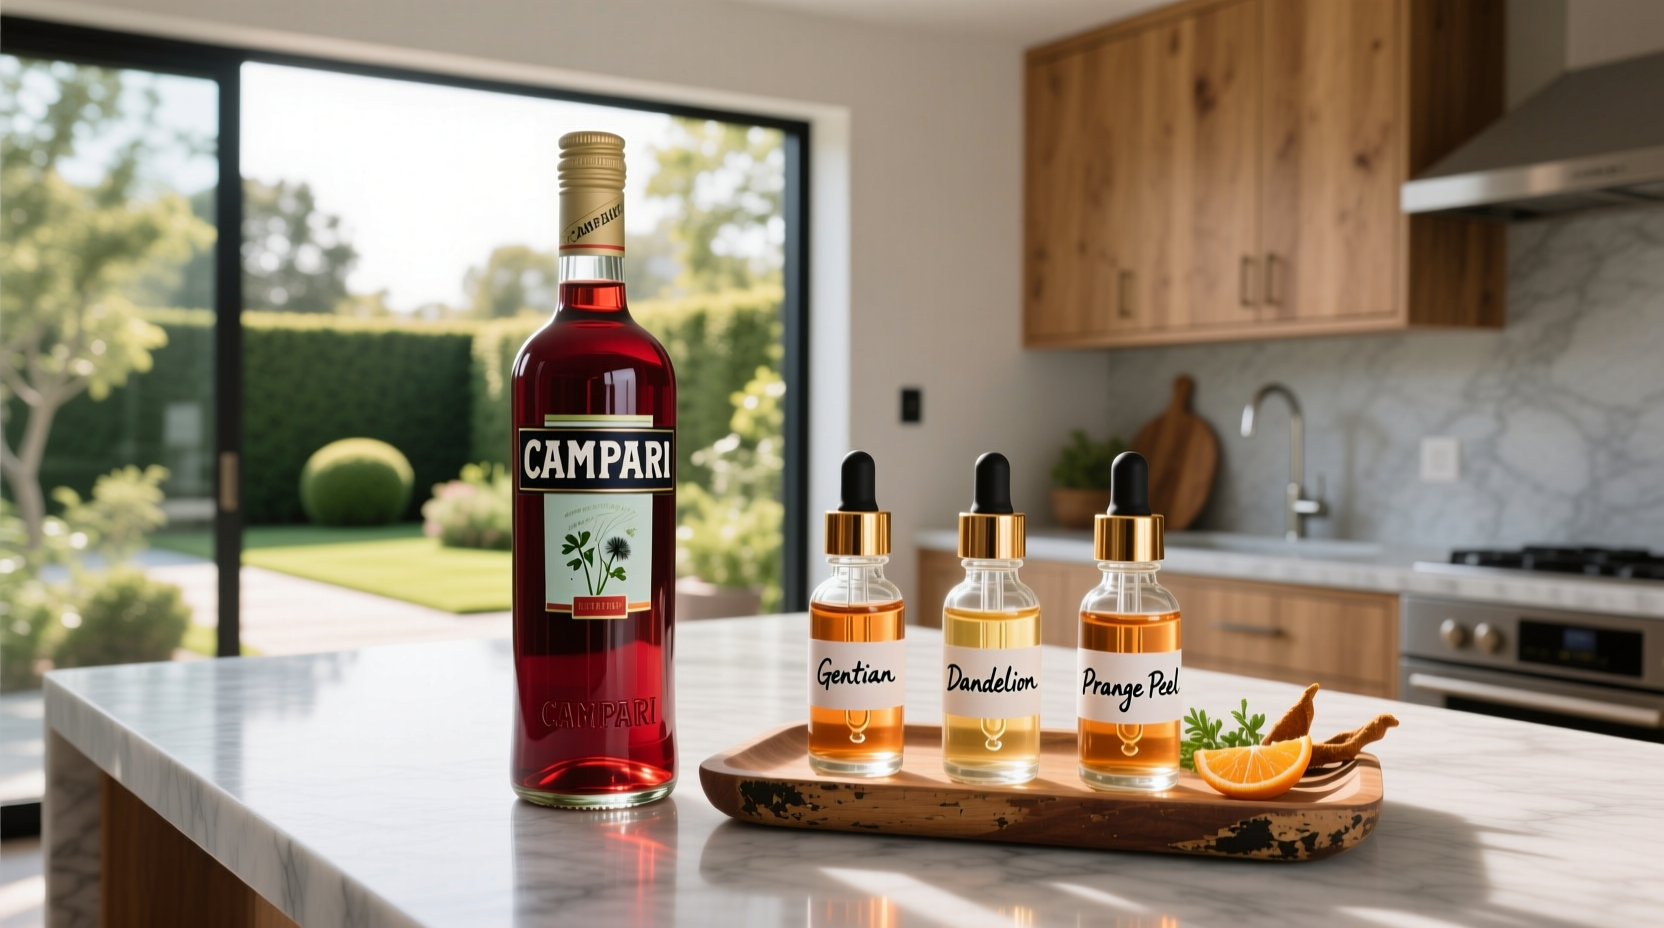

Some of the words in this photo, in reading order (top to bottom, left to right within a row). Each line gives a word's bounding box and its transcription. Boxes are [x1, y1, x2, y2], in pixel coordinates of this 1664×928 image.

[524, 438, 671, 480] CAMPARI
[817, 657, 895, 690] Gentian
[947, 663, 1038, 693] Dandelion
[1148, 666, 1180, 699] Peel
[541, 696, 656, 728] CAMPARI
